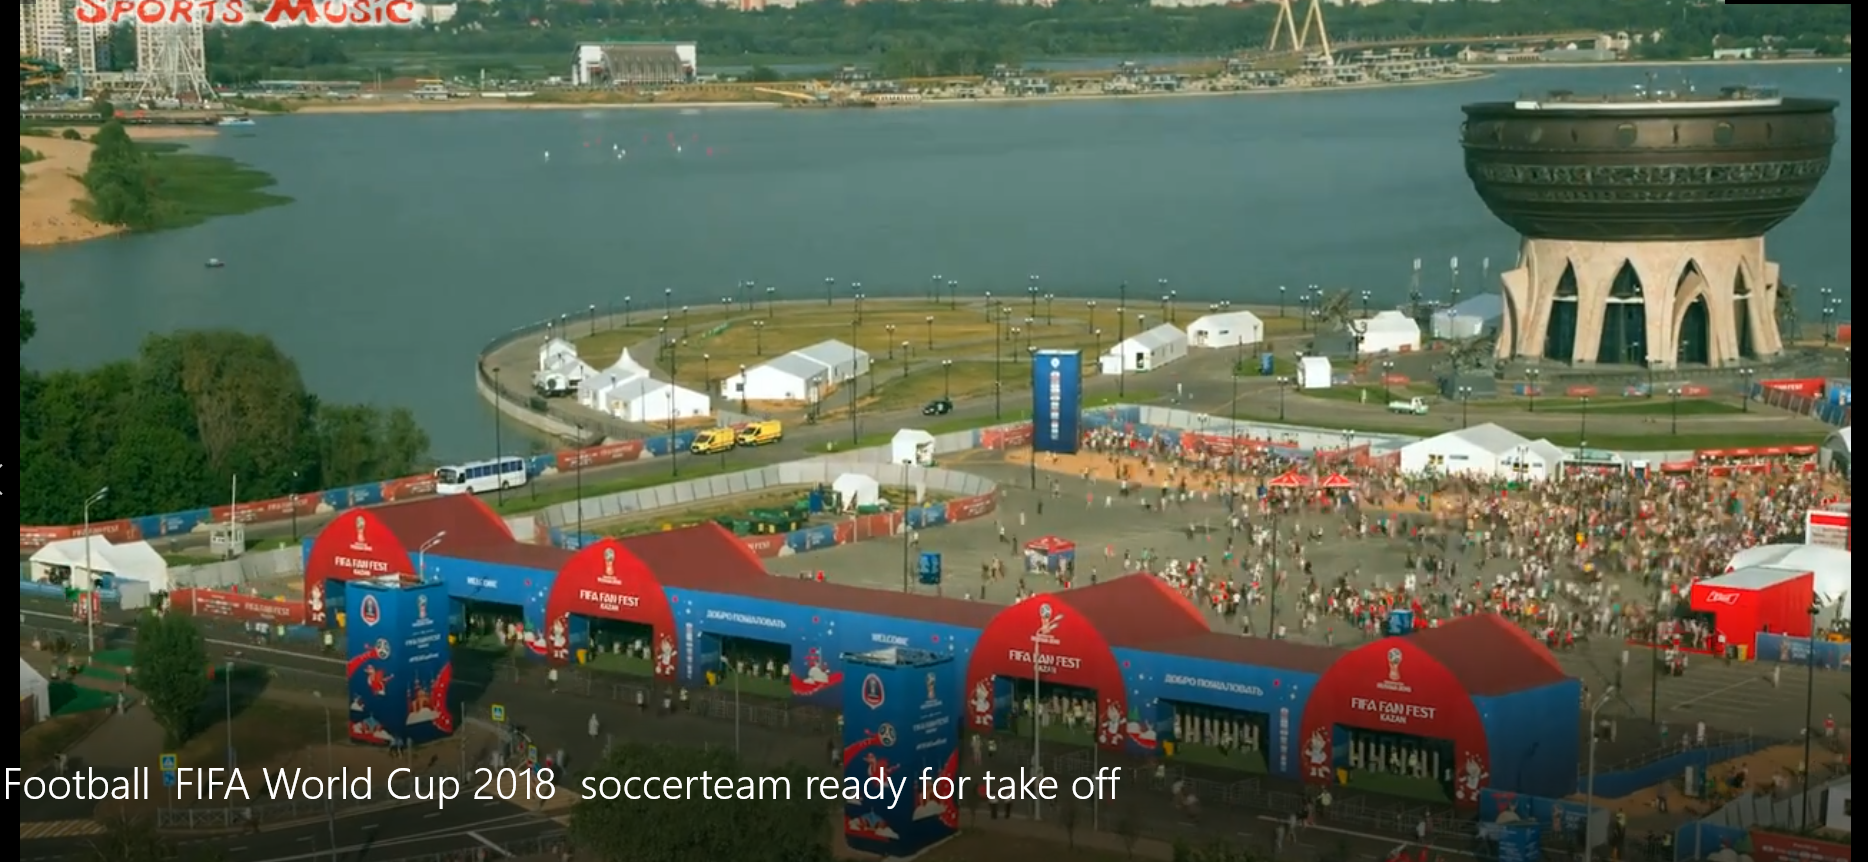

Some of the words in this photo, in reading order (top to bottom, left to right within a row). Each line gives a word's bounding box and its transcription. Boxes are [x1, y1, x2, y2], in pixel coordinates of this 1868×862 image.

[335, 555, 352, 568] FIFA
[369, 560, 388, 572] FEST
[580, 588, 599, 602] FIFA
[599, 592, 617, 603] FAN
[618, 594, 639, 607] FEST
[871, 633, 909, 647] WELCOME
[1009, 649, 1031, 663] FIFA
[1055, 655, 1082, 669] FEST
[1164, 674, 1197, 687] ДОБРО
[1197, 677, 1264, 696] ПОЖАЛОВАТЬ
[1351, 697, 1378, 711] FIFA
[1378, 701, 1405, 715] FAN
[1405, 704, 1437, 719] FEST
[1380, 713, 1408, 724] KAZAN
